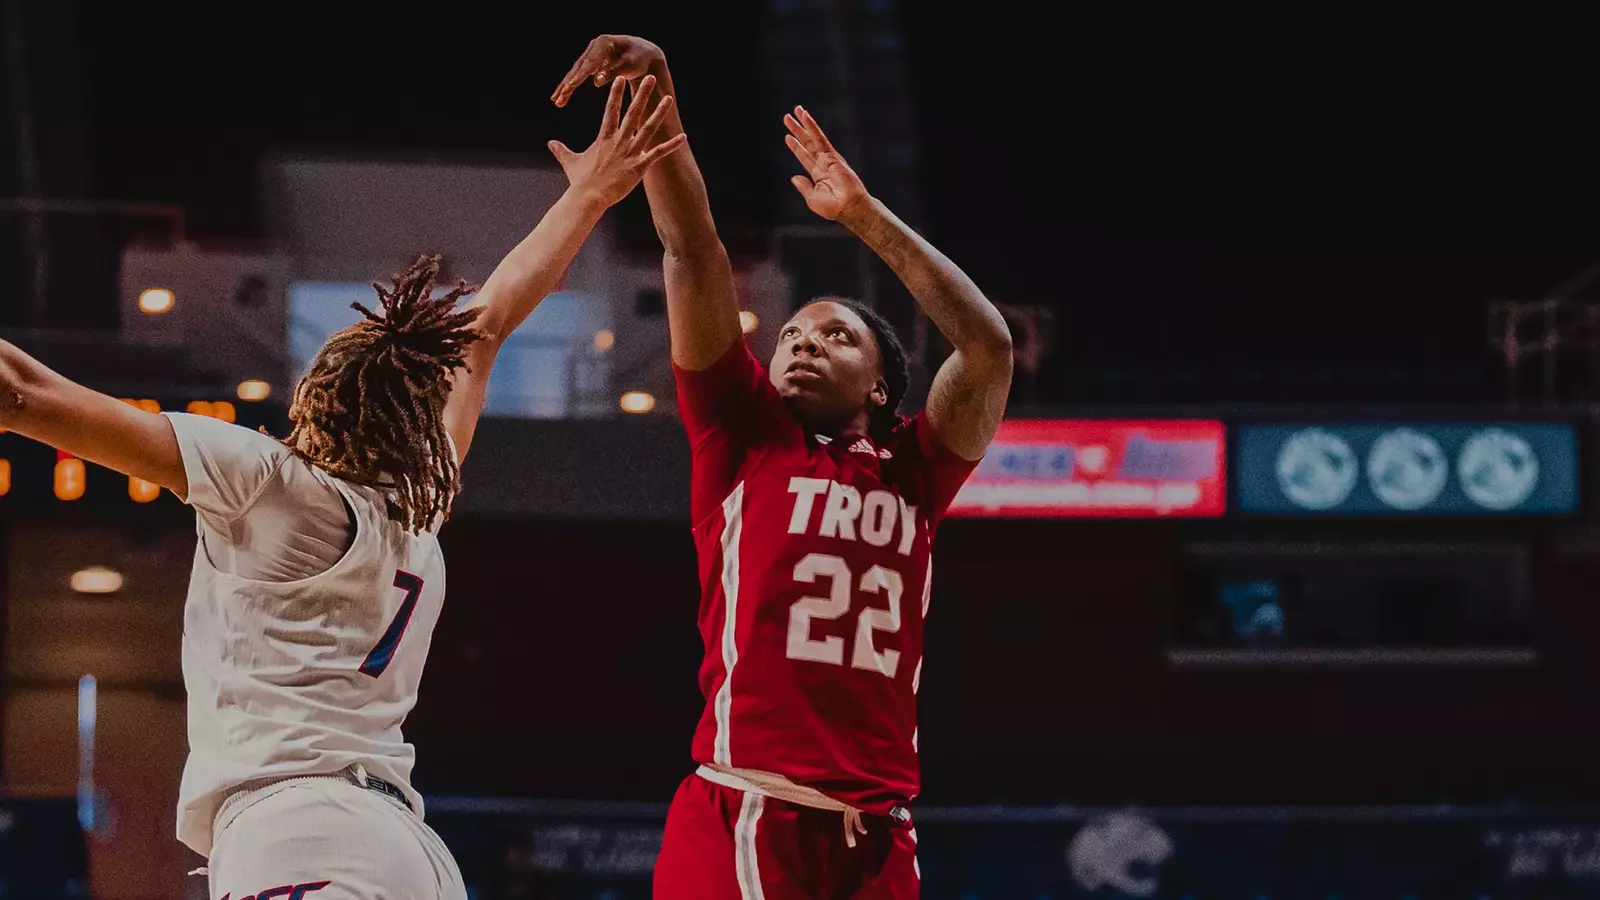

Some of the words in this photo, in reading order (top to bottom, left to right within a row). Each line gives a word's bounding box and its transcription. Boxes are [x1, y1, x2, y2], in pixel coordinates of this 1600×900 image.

[787, 477, 917, 556] TROY
[358, 569, 424, 679] 7
[786, 553, 904, 679] 22
